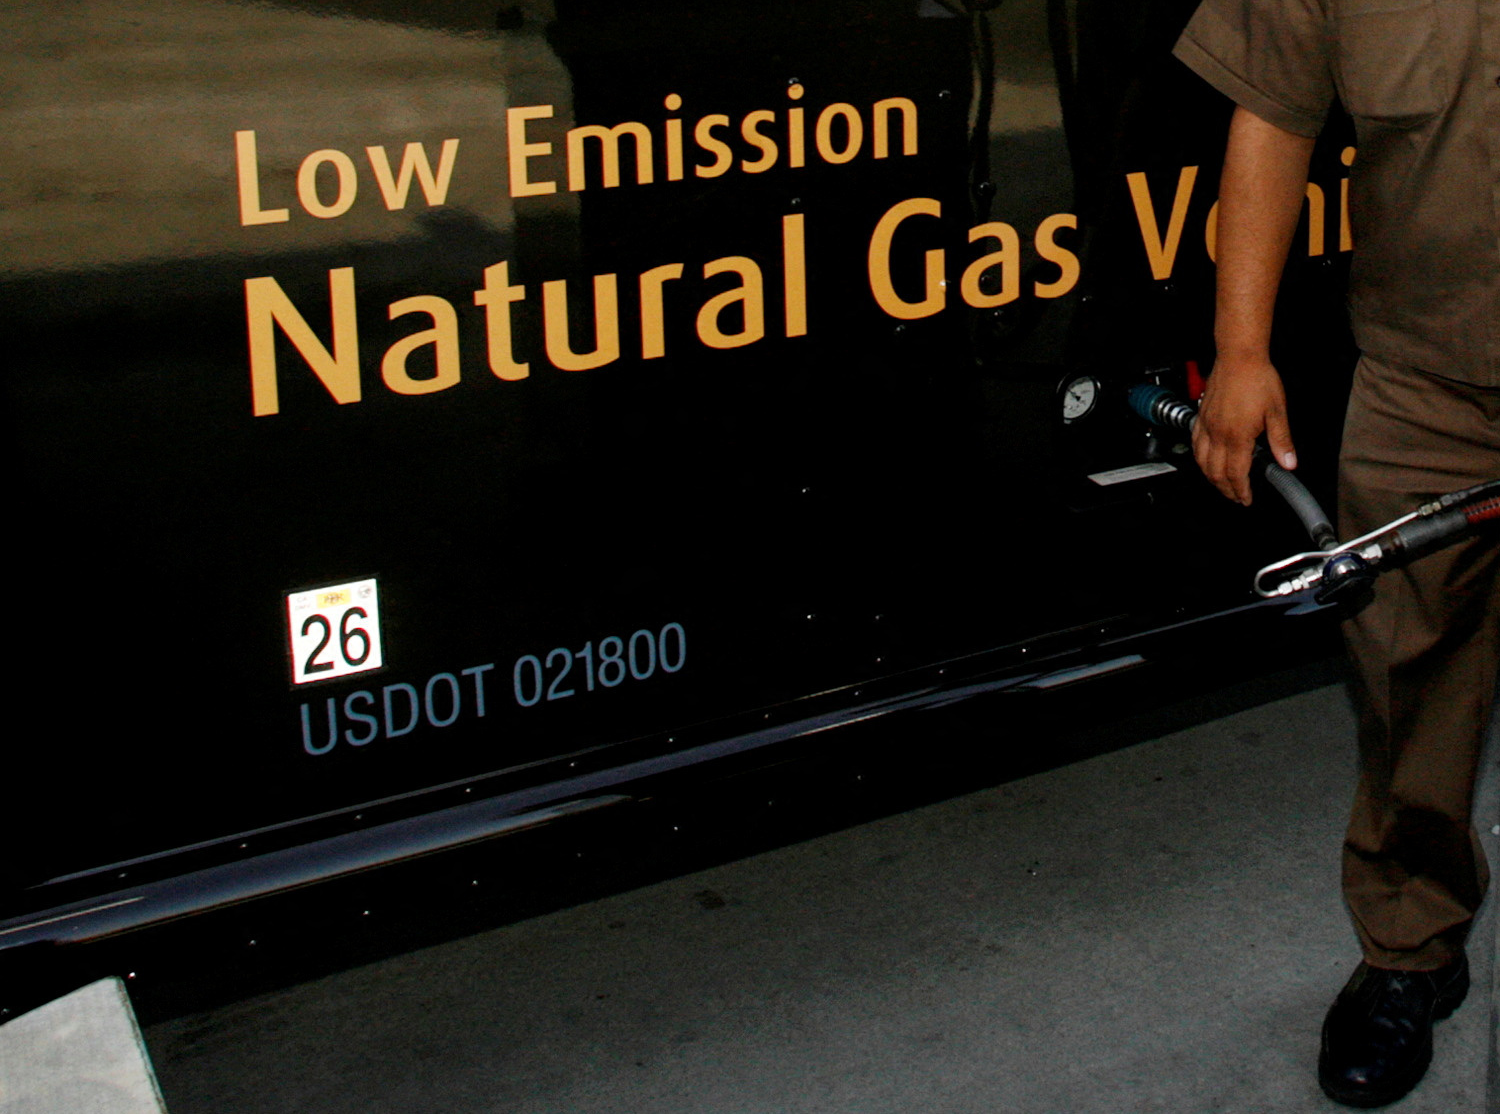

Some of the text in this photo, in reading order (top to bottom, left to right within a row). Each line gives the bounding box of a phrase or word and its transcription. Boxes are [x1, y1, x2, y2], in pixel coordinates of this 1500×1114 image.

[235, 85, 920, 226] Low Emission
[244, 212, 808, 417] Natural
[868, 197, 1081, 320] Gas
[300, 606, 372, 675] 26
[301, 622, 687, 756] USDOT 021800
